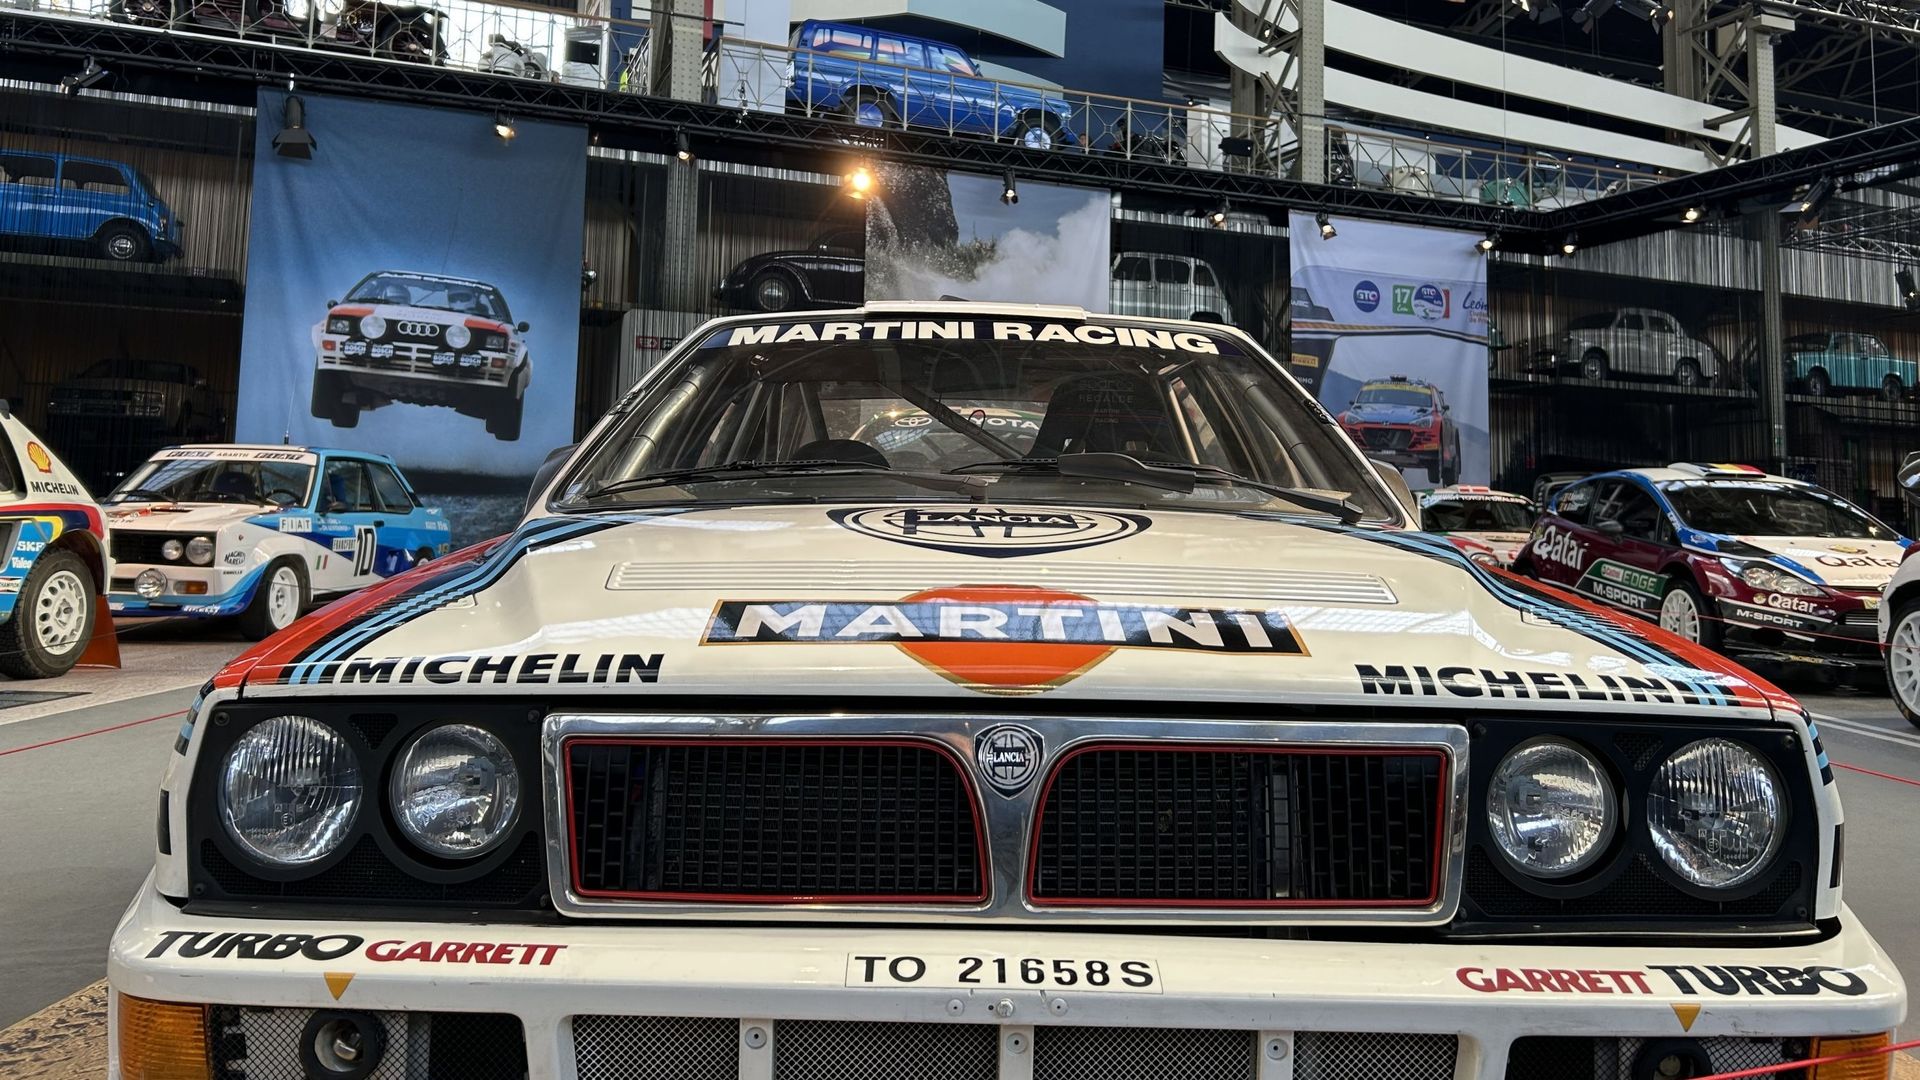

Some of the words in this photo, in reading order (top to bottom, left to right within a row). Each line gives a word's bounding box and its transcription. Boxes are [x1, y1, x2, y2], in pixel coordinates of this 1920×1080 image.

[1394, 288, 1411, 304] 17
[345, 343, 367, 354] BOSCH
[726, 321, 974, 346] MARTINI
[992, 322, 1220, 356] RACING
[371, 345, 394, 356] BOSCH
[432, 353, 455, 364] BOSCH
[459, 355, 482, 366] BOSCH
[30, 481, 79, 495] MICHELIN
[281, 519, 311, 531] FIAT
[917, 513, 1073, 525] LANCIA
[17, 540, 46, 551] SKF
[353, 527, 376, 577] 10
[1532, 525, 1587, 571] Qatar
[1815, 554, 1899, 568] Qata
[1623, 570, 1657, 592] EDGE
[1768, 592, 1818, 613] Qatar
[734, 604, 1275, 650] MARTINI
[1736, 608, 1803, 628] M-SPORT
[340, 652, 665, 684] MICHELIN
[1354, 664, 1686, 704] MICHELIN
[993, 751, 1025, 763] LANCIA
[145, 930, 364, 961] TURBO
[365, 940, 568, 966] GARRETT
[855, 956, 927, 983] TO
[1456, 966, 1653, 995] GARRETT
[1646, 965, 1868, 996] TURBO
